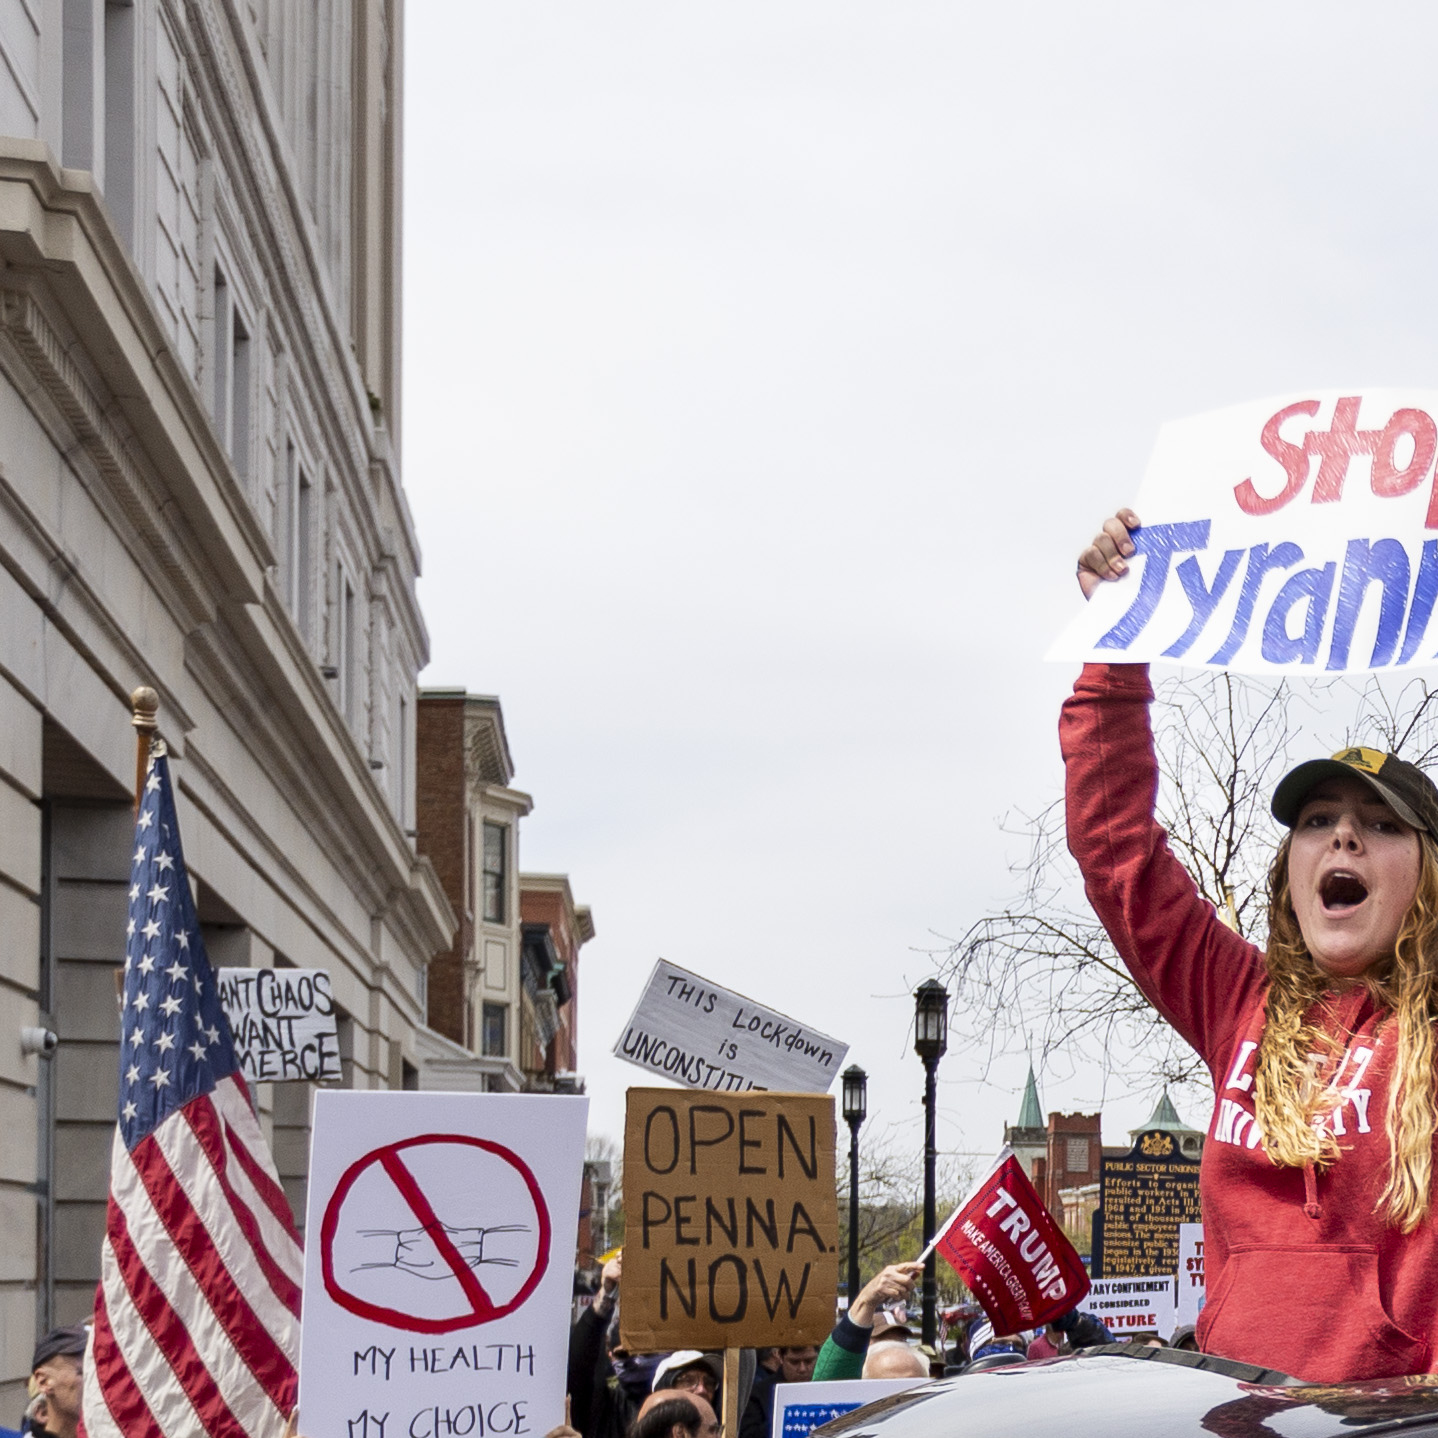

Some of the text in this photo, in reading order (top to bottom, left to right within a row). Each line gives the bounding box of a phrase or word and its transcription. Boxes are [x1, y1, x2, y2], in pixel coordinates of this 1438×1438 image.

[667, 974, 718, 1014] THIS
[644, 1104, 817, 1181] OPEN
[1104, 1162, 1133, 1172] PUBLIC
[1136, 1162, 1166, 1173] SECTOR
[960, 1219, 986, 1247] MAKE
[979, 1240, 1013, 1281] AMERICA
[985, 1186, 1068, 1302] TRUMP
[659, 1253, 812, 1324] NOW
[1089, 1299, 1150, 1310] IS CONSIDERED
[1111, 1280, 1170, 1294] CONFINEMENT
[1098, 1313, 1157, 1329] RTURE
[353, 1344, 537, 1380] MY HEALTH
